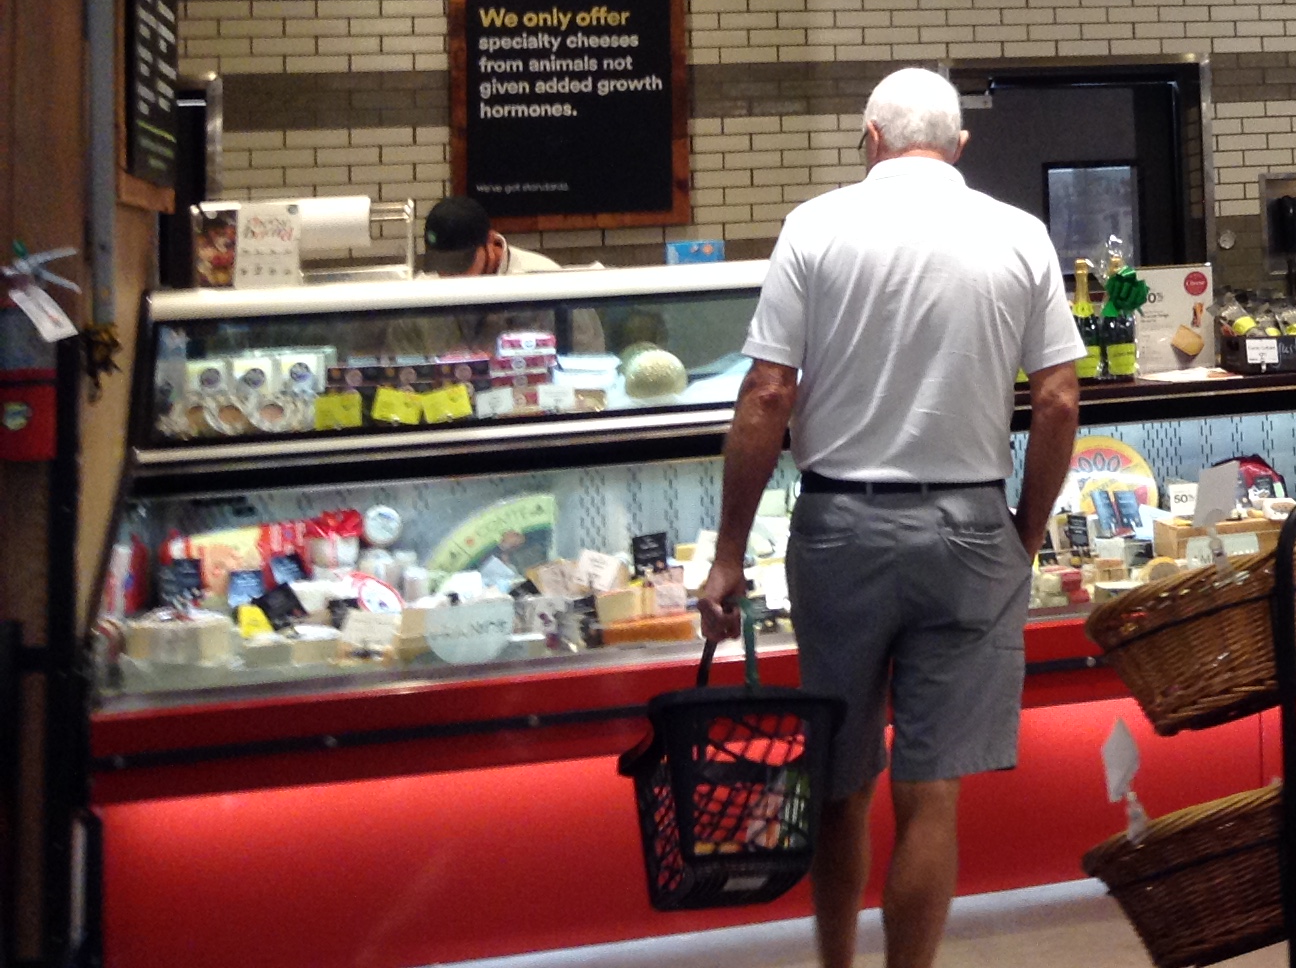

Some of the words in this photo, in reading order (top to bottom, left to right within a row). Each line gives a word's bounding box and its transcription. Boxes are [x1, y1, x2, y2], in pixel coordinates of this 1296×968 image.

[479, 7, 518, 28] We
[523, 6, 572, 30] only
[576, 5, 631, 27] offer
[478, 31, 561, 52] specialty
[566, 31, 640, 48] cheeses
[478, 55, 523, 73] from
[529, 54, 598, 72] animals
[603, 54, 633, 71] not
[479, 78, 530, 99] given
[535, 75, 593, 94] added
[597, 74, 663, 96] growth
[480, 102, 578, 119] hormones.
